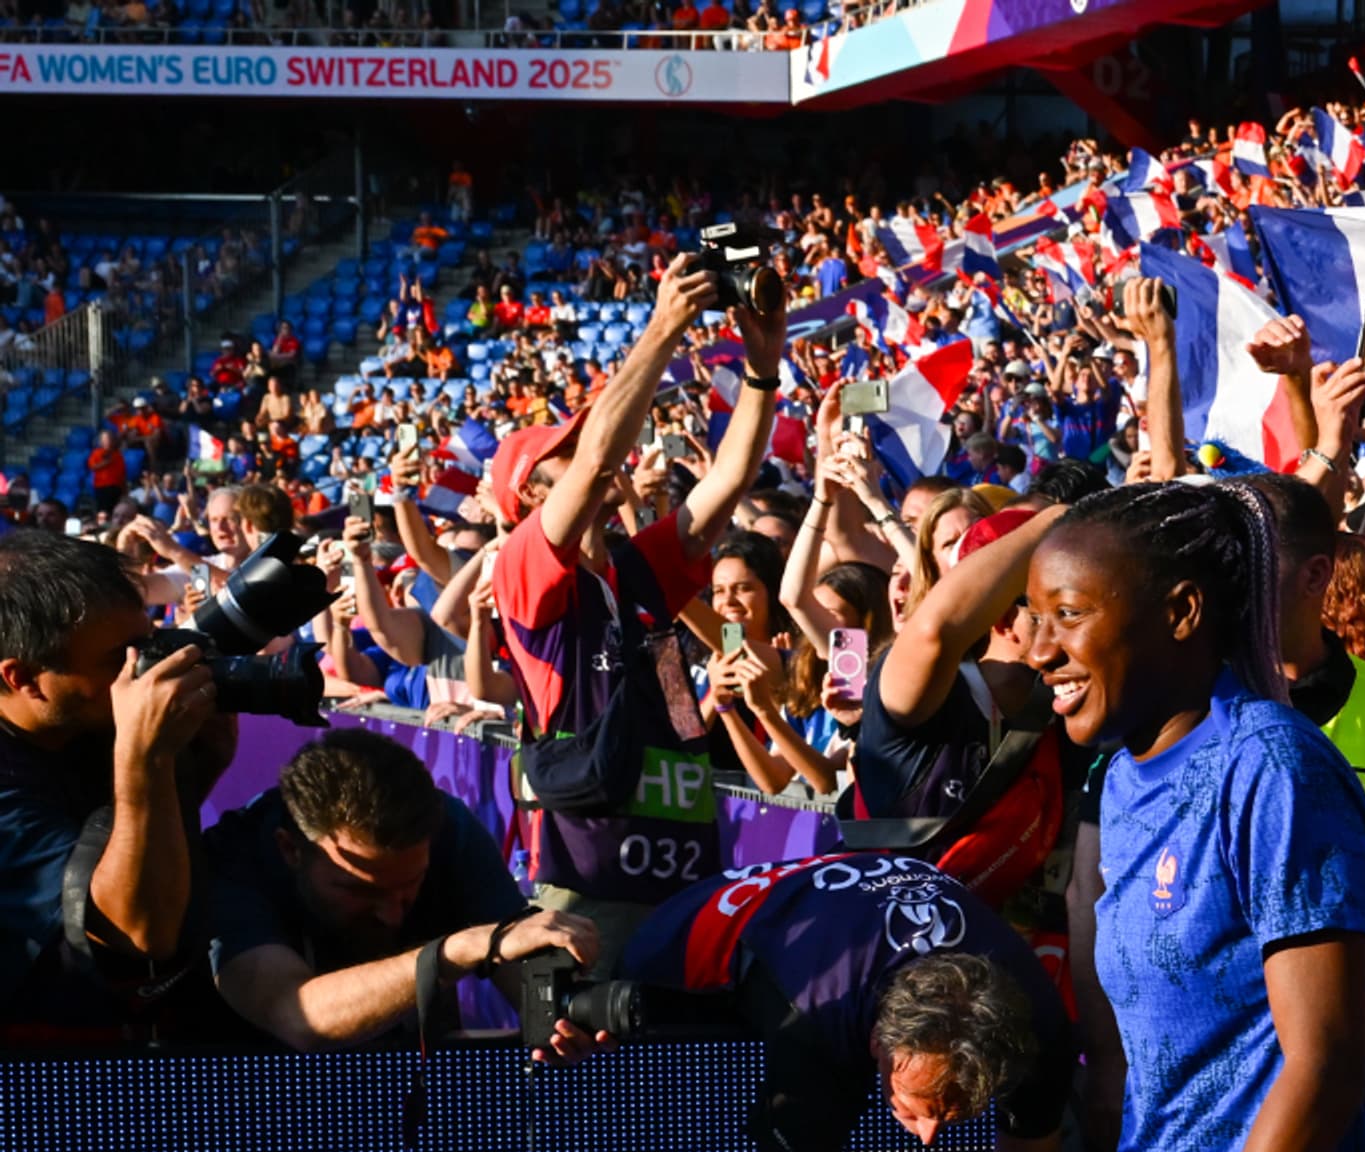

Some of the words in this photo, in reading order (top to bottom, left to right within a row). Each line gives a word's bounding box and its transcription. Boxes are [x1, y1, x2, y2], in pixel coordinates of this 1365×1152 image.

[37, 53, 184, 84] WOMEN'S
[192, 55, 277, 86] EURO
[286, 56, 518, 88] SWITZERLAND
[619, 834, 702, 881] 032
